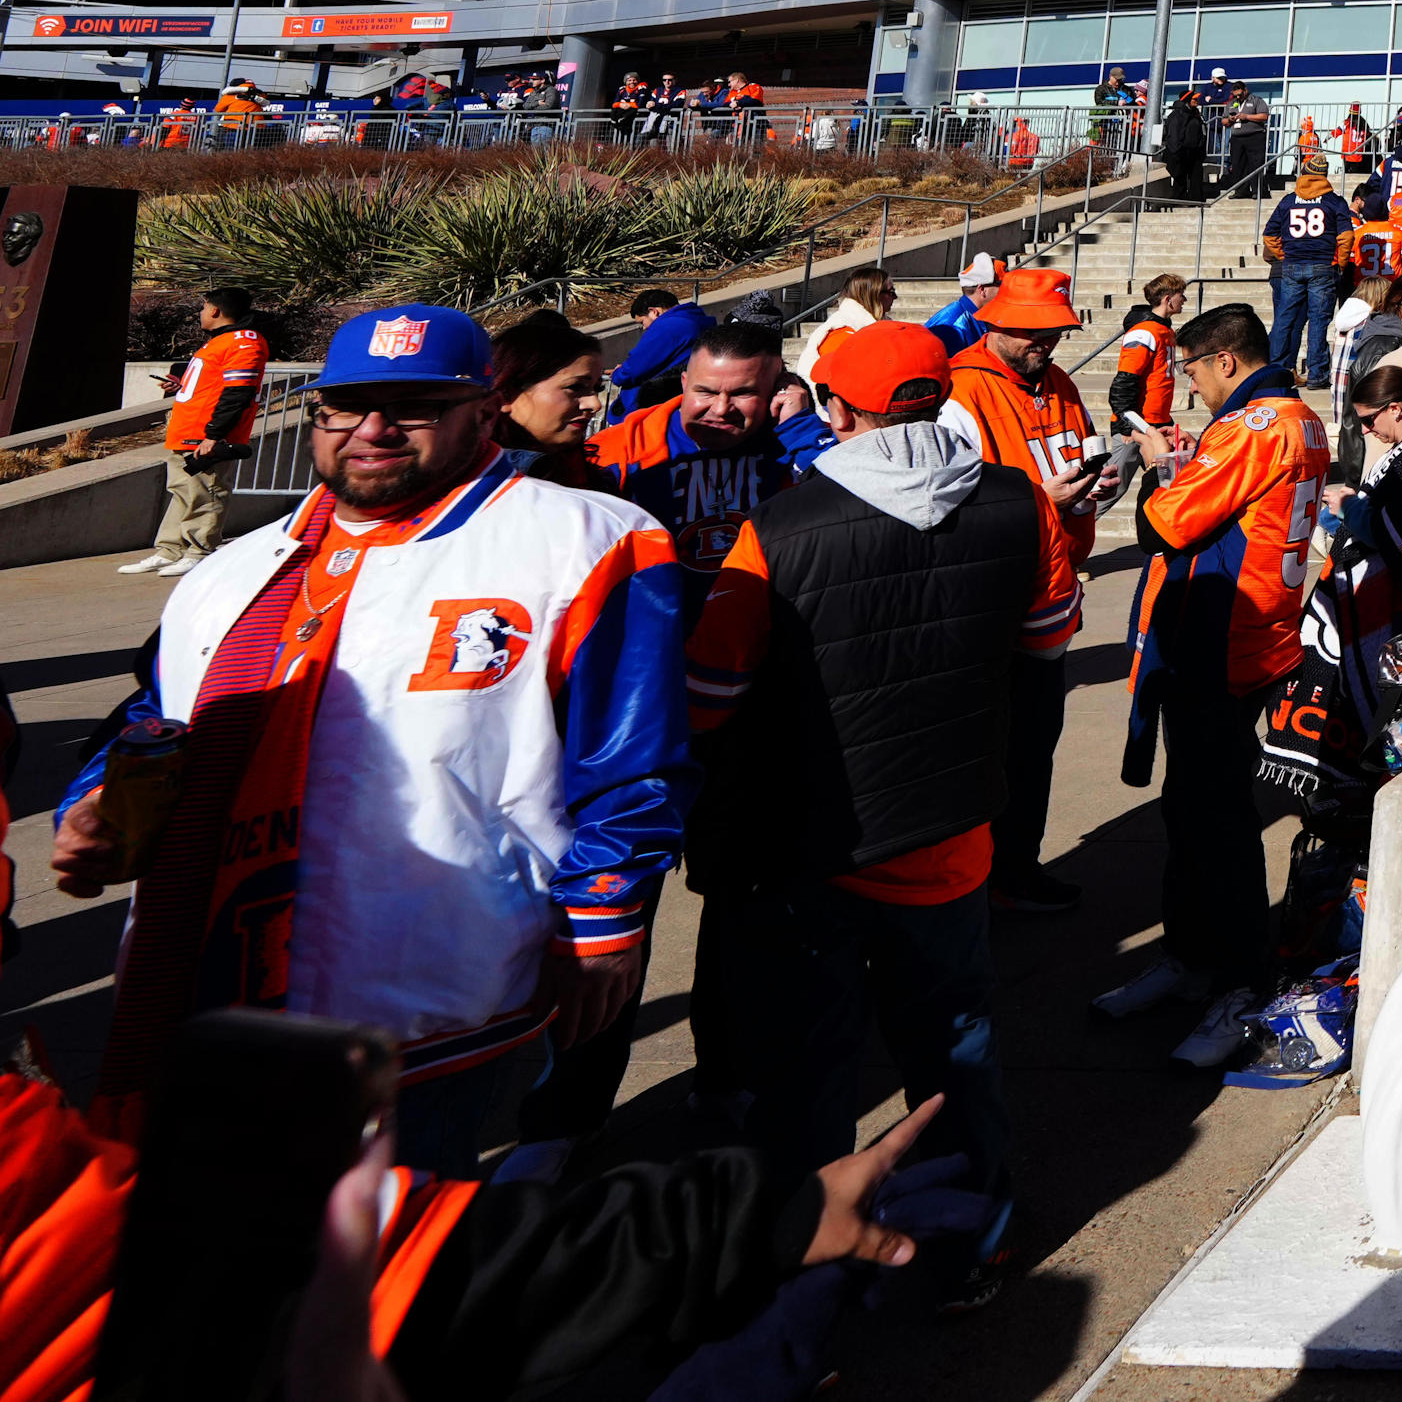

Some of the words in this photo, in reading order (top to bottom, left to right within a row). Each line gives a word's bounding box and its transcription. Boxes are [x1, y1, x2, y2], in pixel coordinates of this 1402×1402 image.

[70, 18, 114, 33] JOIN
[119, 18, 158, 33] WIFI
[1289, 208, 1325, 238] 58
[1360, 243, 1395, 276] 31
[234, 329, 258, 340] 10
[1282, 472, 1328, 589] 5
